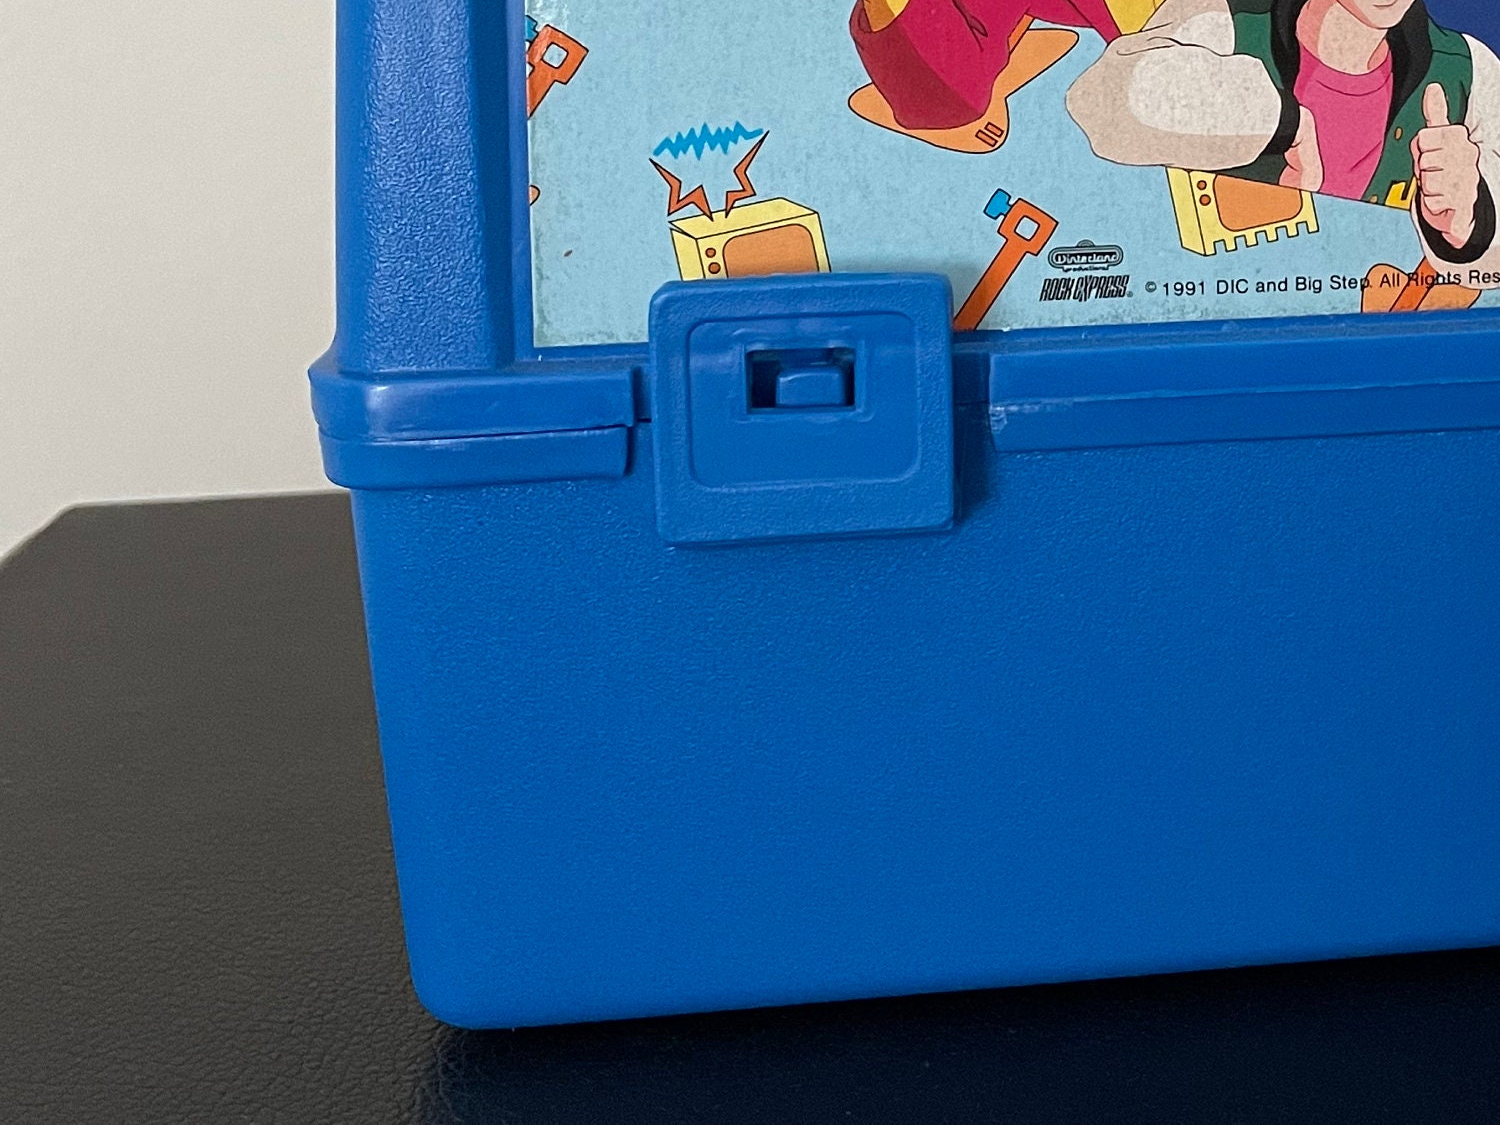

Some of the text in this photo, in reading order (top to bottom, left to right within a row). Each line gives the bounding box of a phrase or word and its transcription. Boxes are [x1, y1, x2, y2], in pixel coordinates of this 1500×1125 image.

[1162, 282, 1206, 296] 1991
[1216, 279, 1249, 294] DIC
[1255, 277, 1288, 293] and
[1295, 276, 1322, 294] Big
[1379, 273, 1400, 289] All
[1408, 270, 1462, 290] Rights
